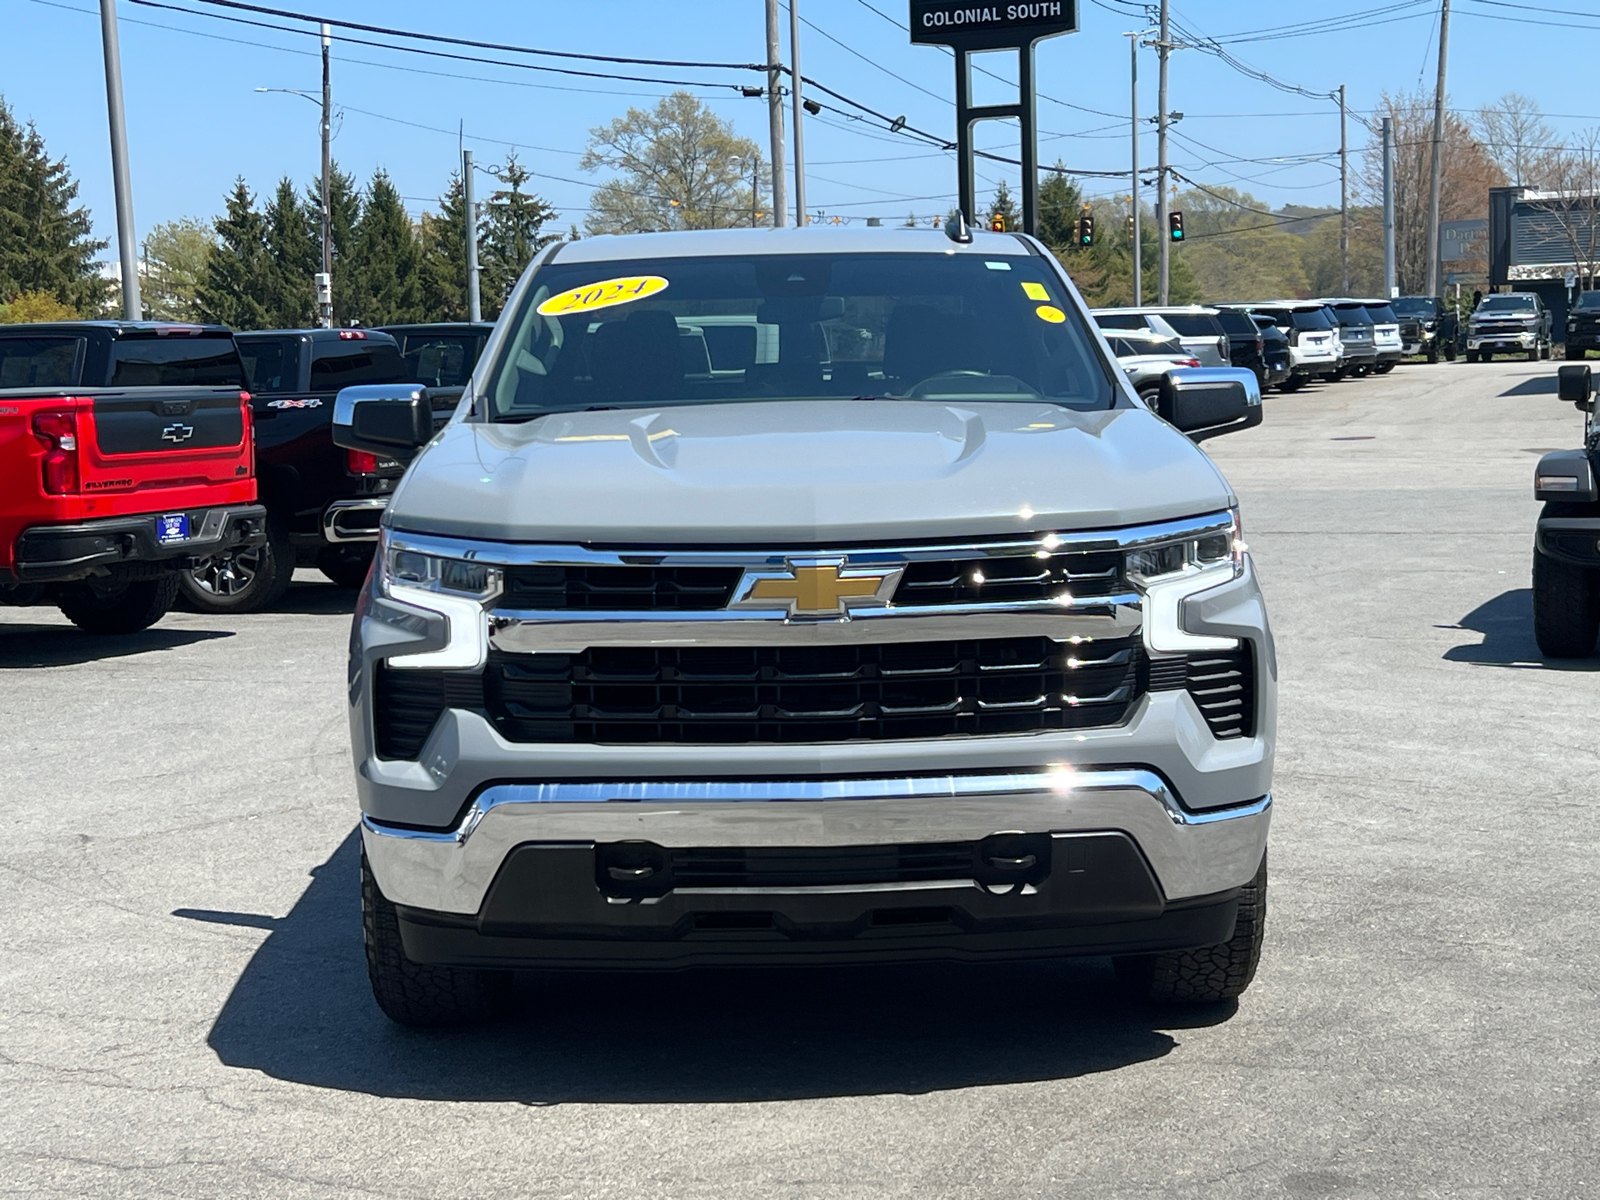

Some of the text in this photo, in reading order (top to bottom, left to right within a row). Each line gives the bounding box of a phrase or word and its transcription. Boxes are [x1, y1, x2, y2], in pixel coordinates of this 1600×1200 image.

[922, 1, 1061, 27] COLONIAL SOUTH
[560, 279, 648, 311] 2024
